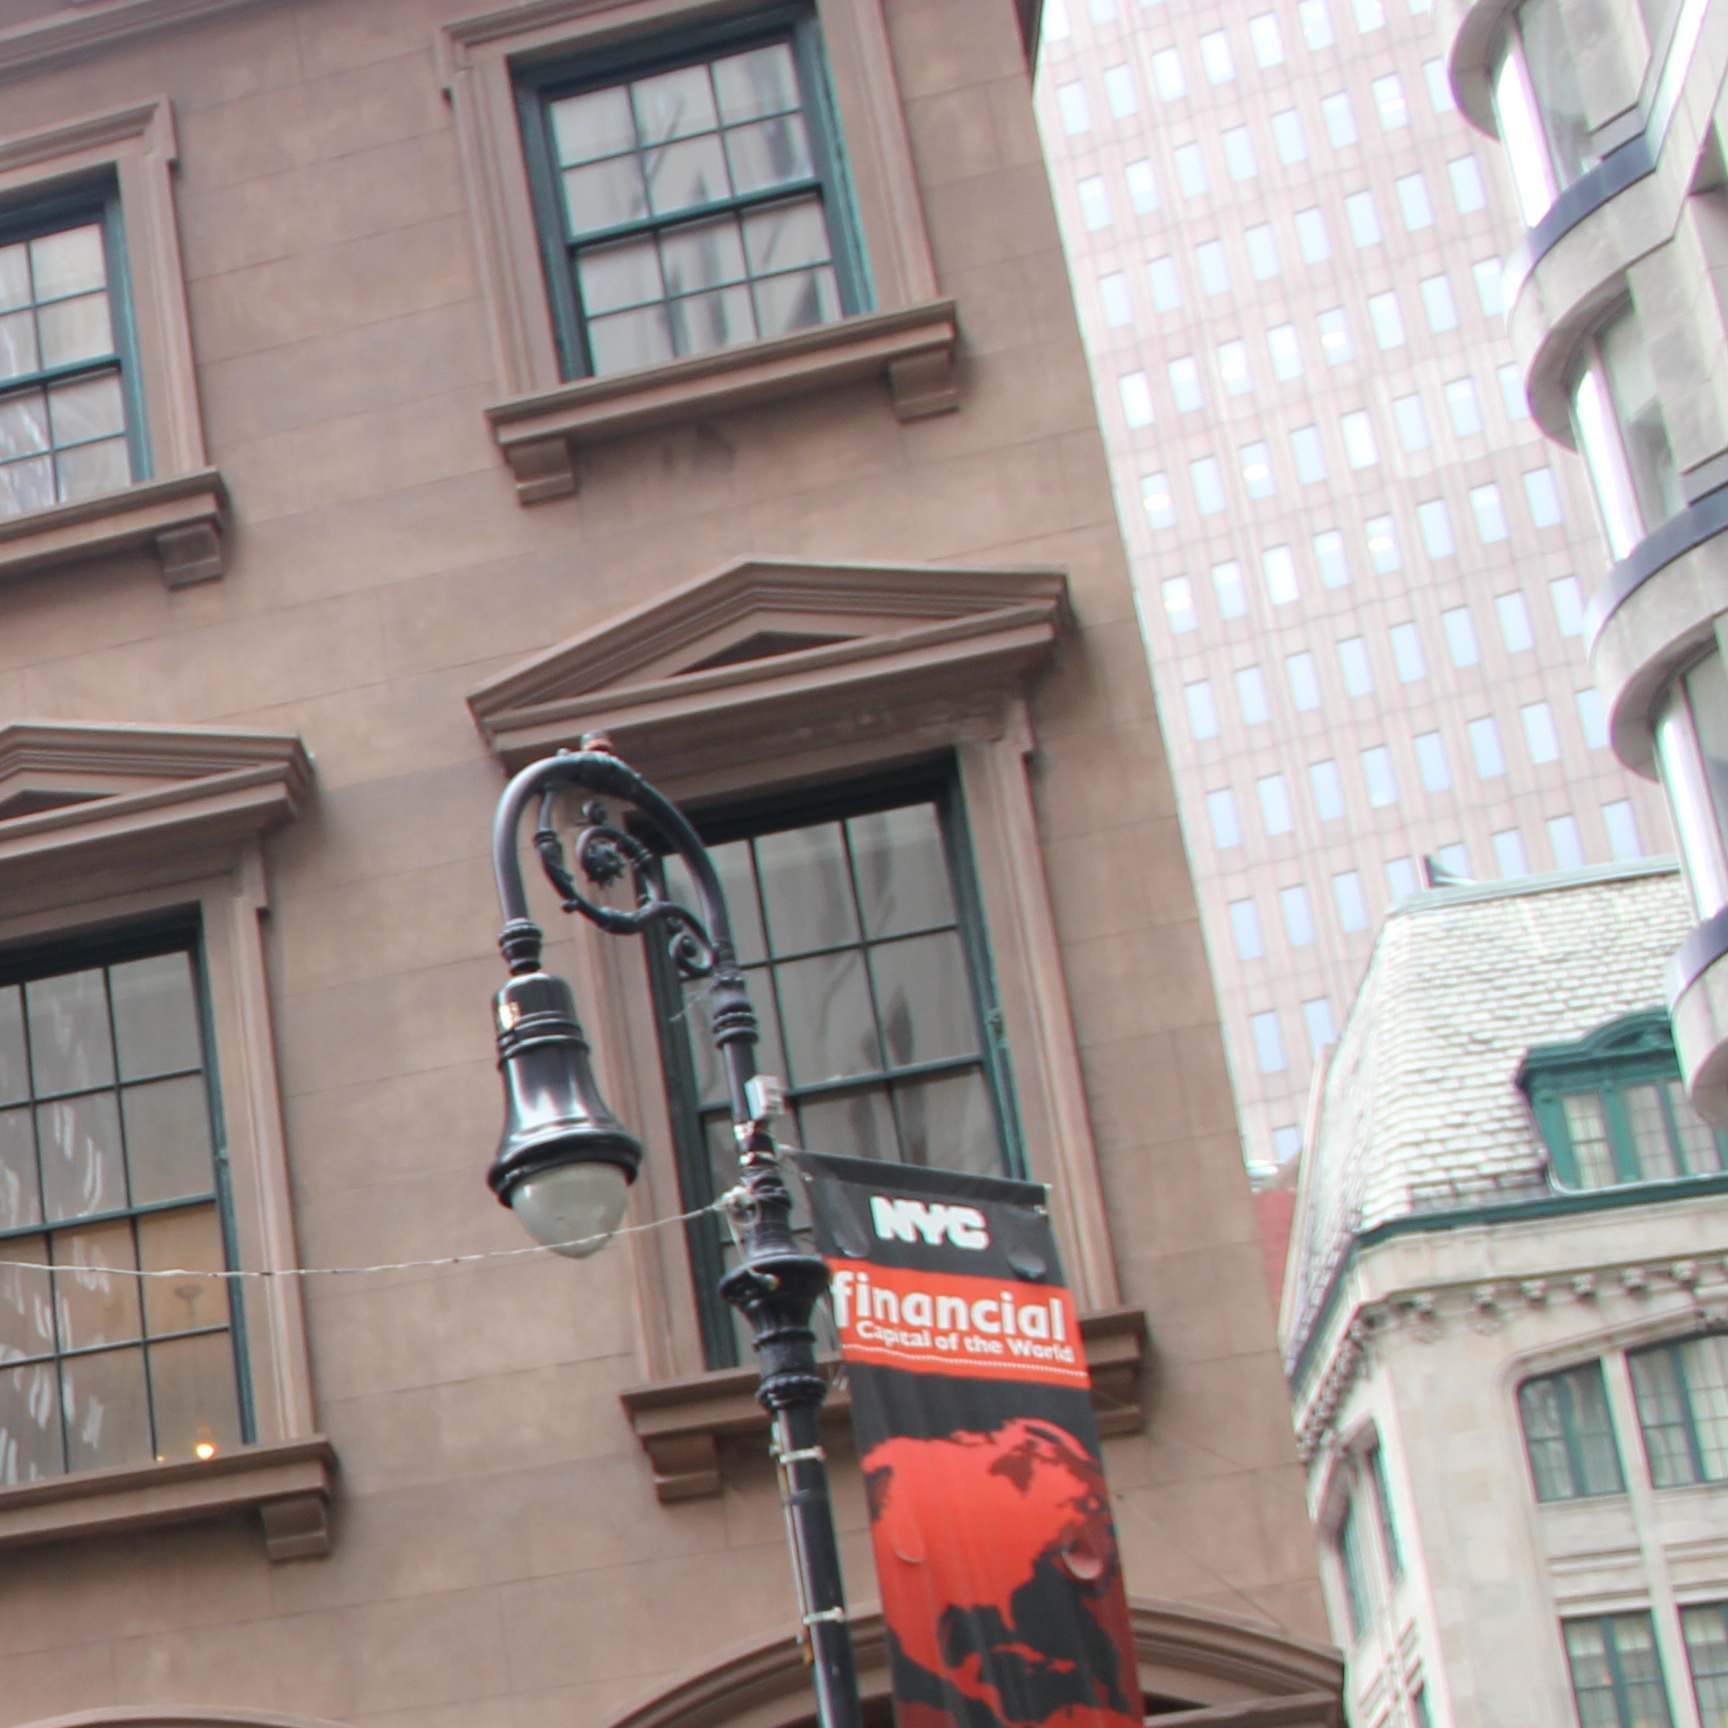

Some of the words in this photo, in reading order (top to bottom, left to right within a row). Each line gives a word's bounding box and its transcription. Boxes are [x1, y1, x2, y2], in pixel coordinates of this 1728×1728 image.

[870, 1196, 990, 1250] NYC
[831, 1270, 1066, 1342] financial
[856, 1320, 932, 1347] Capital
[935, 1332, 960, 1350] of
[963, 1335, 1005, 1355] the
[1005, 1338, 1075, 1363] World
